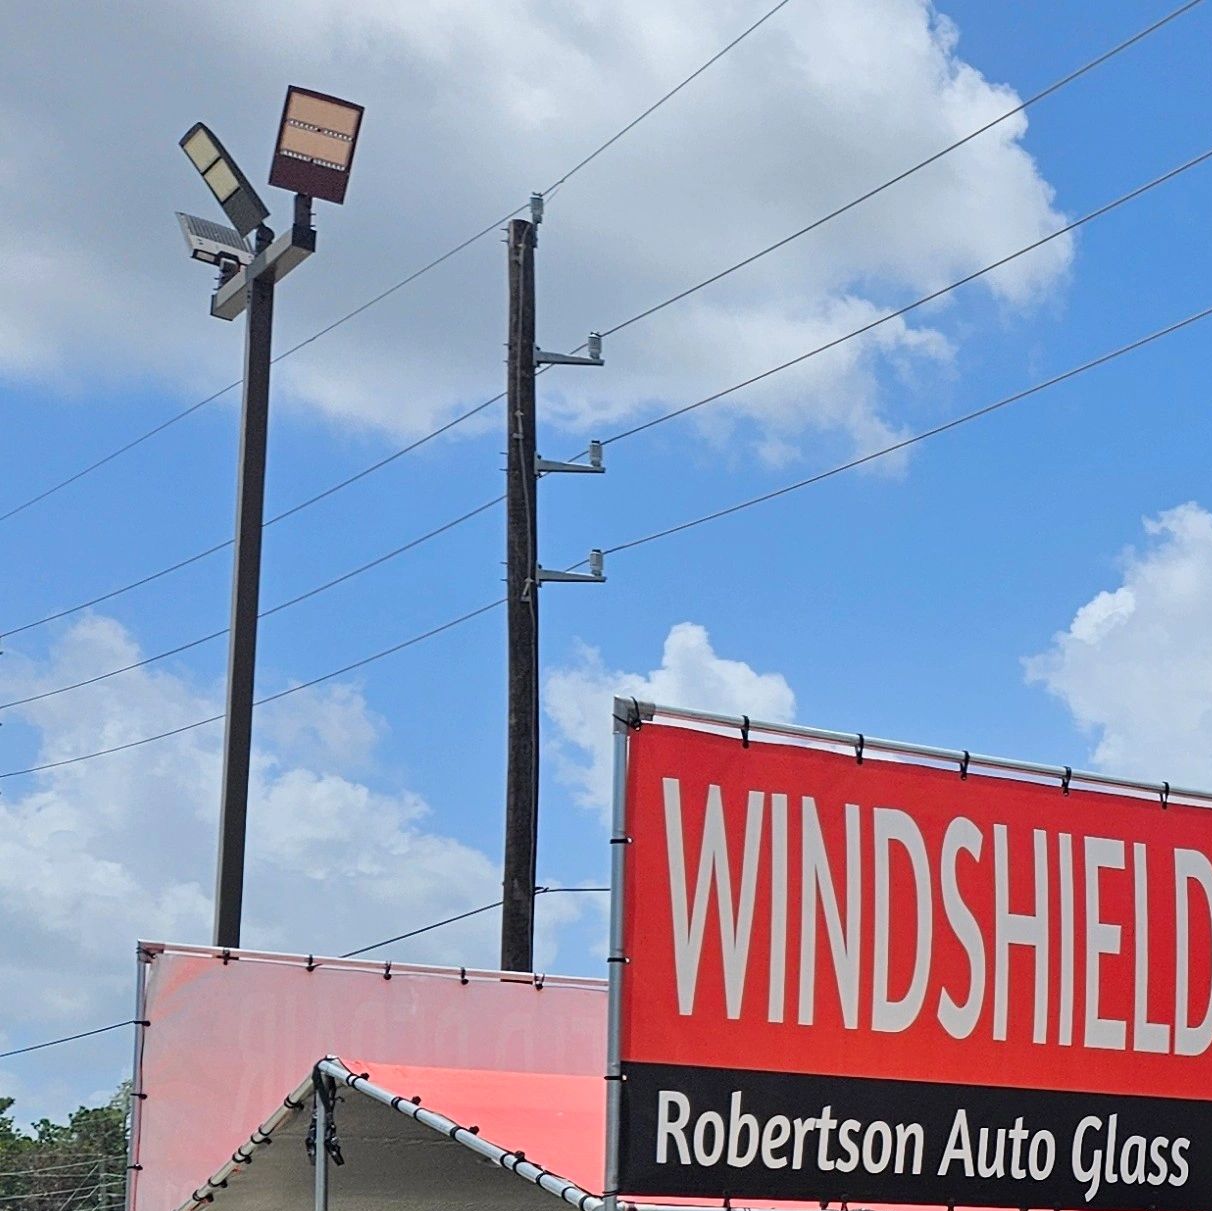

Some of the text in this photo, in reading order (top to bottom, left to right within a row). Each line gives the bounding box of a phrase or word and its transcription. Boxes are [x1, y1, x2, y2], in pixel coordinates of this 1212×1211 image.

[656, 1090, 1191, 1202] Robertson Auto Glass
